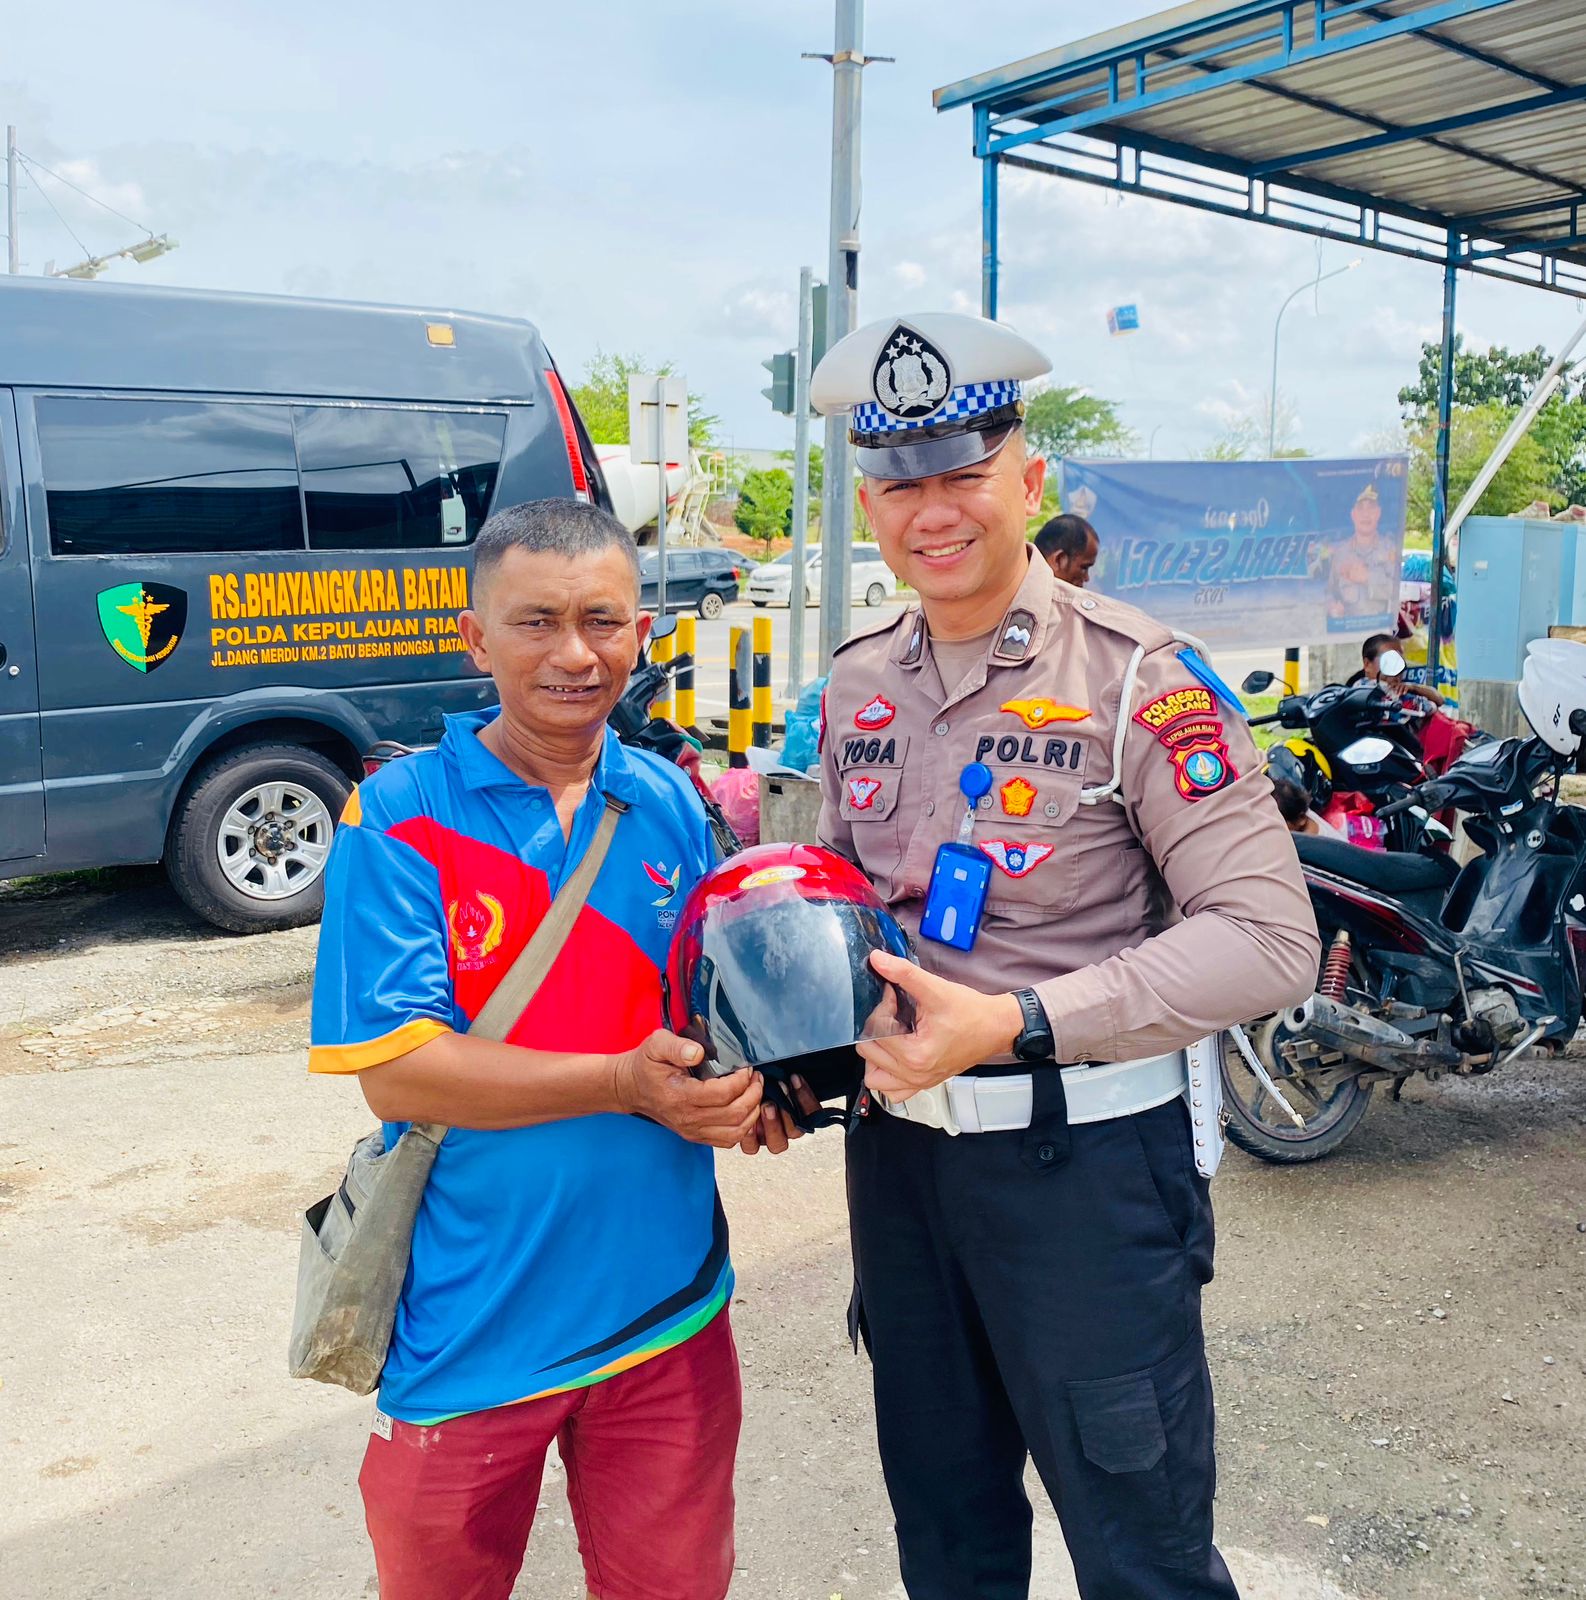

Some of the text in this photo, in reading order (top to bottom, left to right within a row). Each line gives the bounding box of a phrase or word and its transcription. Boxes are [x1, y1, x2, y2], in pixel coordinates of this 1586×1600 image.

[209, 567, 468, 620] RS.BHAYANGKARA BATAM
[211, 616, 459, 646] POLDA KEPULAUAN RIA
[211, 648, 259, 667] JL.DANG
[261, 646, 299, 664] MERDU
[302, 645, 327, 661] KM.2
[329, 643, 356, 660] BATU
[358, 642, 391, 658] BESAR
[393, 639, 436, 656] NONGSA
[1141, 689, 1211, 724] POLRESTA
[1201, 724, 1216, 732] RIAU
[843, 736, 896, 765] YOGA
[975, 735, 1081, 769] POLRI
[657, 910, 675, 919] PON
